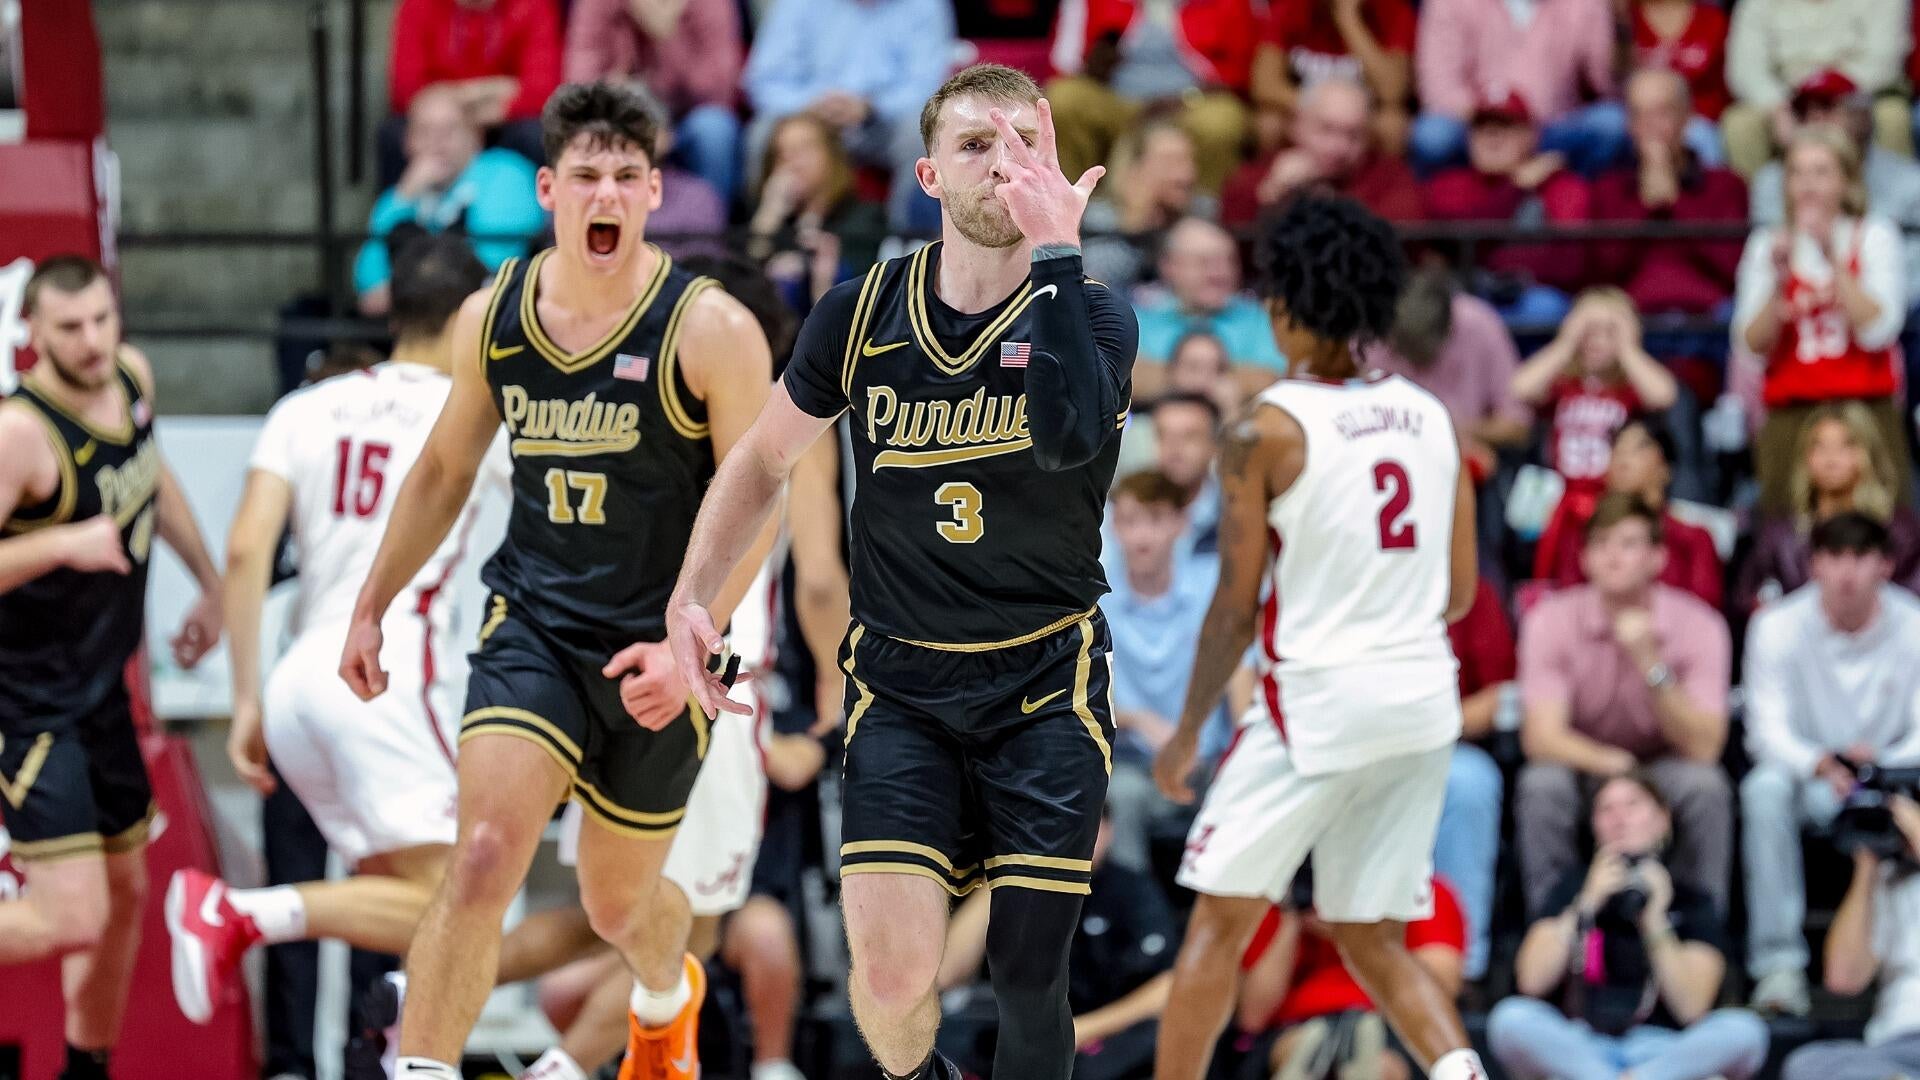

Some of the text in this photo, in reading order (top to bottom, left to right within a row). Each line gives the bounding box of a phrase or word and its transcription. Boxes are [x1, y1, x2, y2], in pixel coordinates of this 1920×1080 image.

[502, 385, 640, 442] Purdue
[335, 436, 391, 517] 15
[544, 468, 607, 525] 17
[1372, 460, 1417, 550] 2
[934, 482, 984, 543] 3
